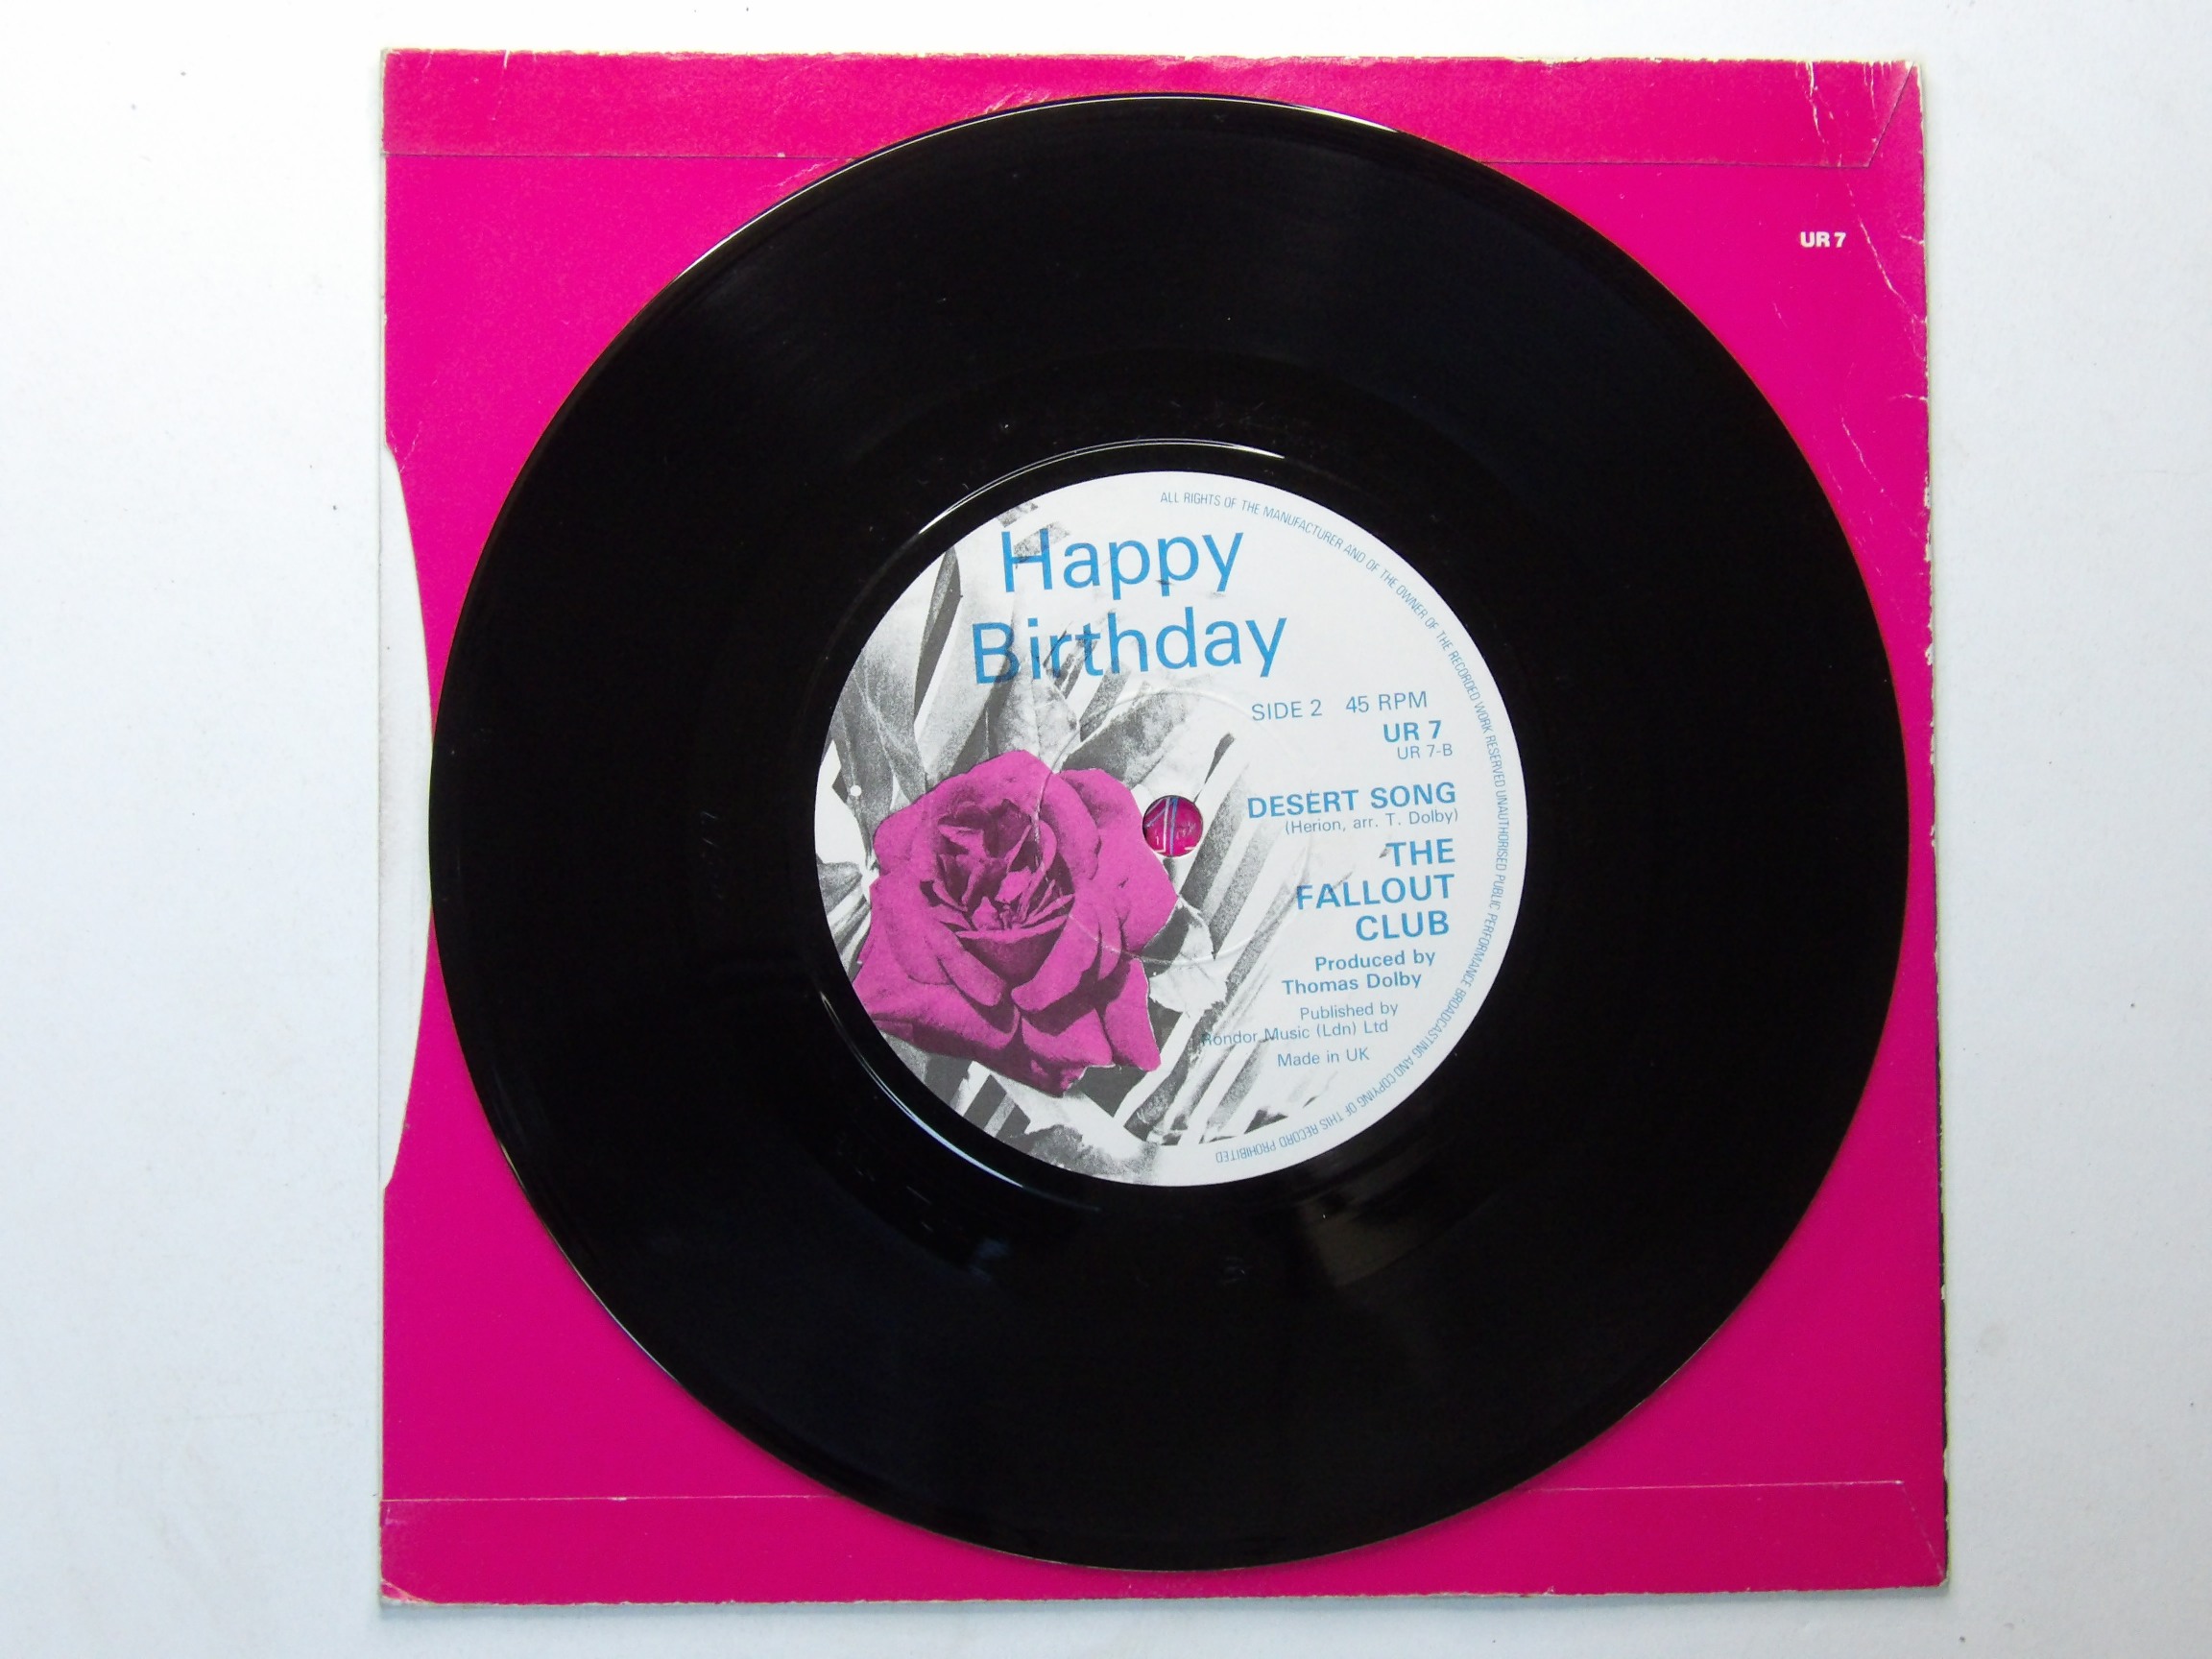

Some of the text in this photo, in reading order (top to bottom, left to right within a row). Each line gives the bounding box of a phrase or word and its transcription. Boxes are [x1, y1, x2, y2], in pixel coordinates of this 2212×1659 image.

[1800, 231, 1847, 248] UR 7
[1001, 528, 1244, 600] Happy
[972, 607, 1287, 685] Birthday
[1251, 690, 1428, 721] SIDE 2 45 RPM
[1382, 720, 1442, 743] UR 7
[1397, 743, 1454, 760] UR 7-B
[1247, 781, 1456, 819] DESERT SONG
[1160, 492, 1508, 1163] ALL RIGHTS OF THE MANUFACTURER AND OF THE OWNER OF THE RECORDED WORK RESERVED UNAUTHORISED PUBLIC PERFORMANCE BROADCASTING AND COPYING OF THIS RECORD PROHIBITED
[1285, 807, 1459, 835] (Herion, arr. T. Dolby)
[1385, 837, 1455, 867] THE
[1296, 873, 1455, 910] FALLOUT
[1356, 910, 1450, 942] CLUB
[1314, 949, 1436, 972] Produced by
[1282, 971, 1422, 995] Thomas Dolby
[1300, 1001, 1399, 1021] Published by
[1201, 1020, 1389, 1046] Rondor Music (Ldn) Ltd
[1277, 1046, 1370, 1068] Made in UK
